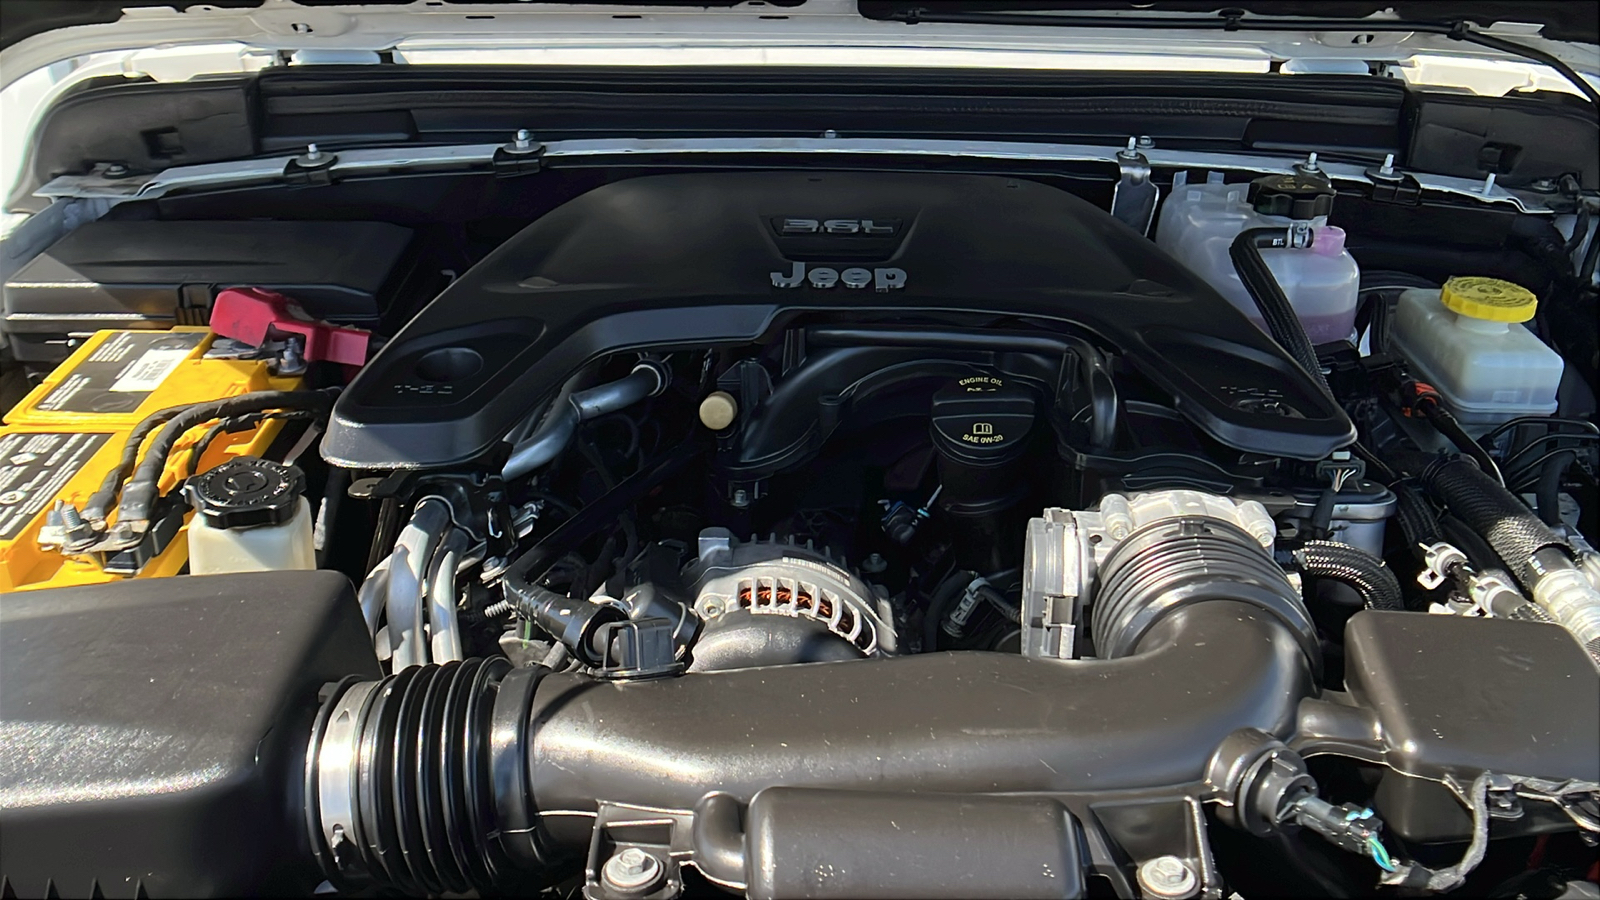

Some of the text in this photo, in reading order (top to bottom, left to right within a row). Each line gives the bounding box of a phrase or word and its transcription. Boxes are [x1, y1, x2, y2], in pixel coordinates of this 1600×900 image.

[783, 218, 893, 233] 3.6L
[770, 261, 907, 292] Jeep
[959, 377, 1003, 386] ENGINE OIL
[962, 434, 1004, 444] SAE 0W-20
